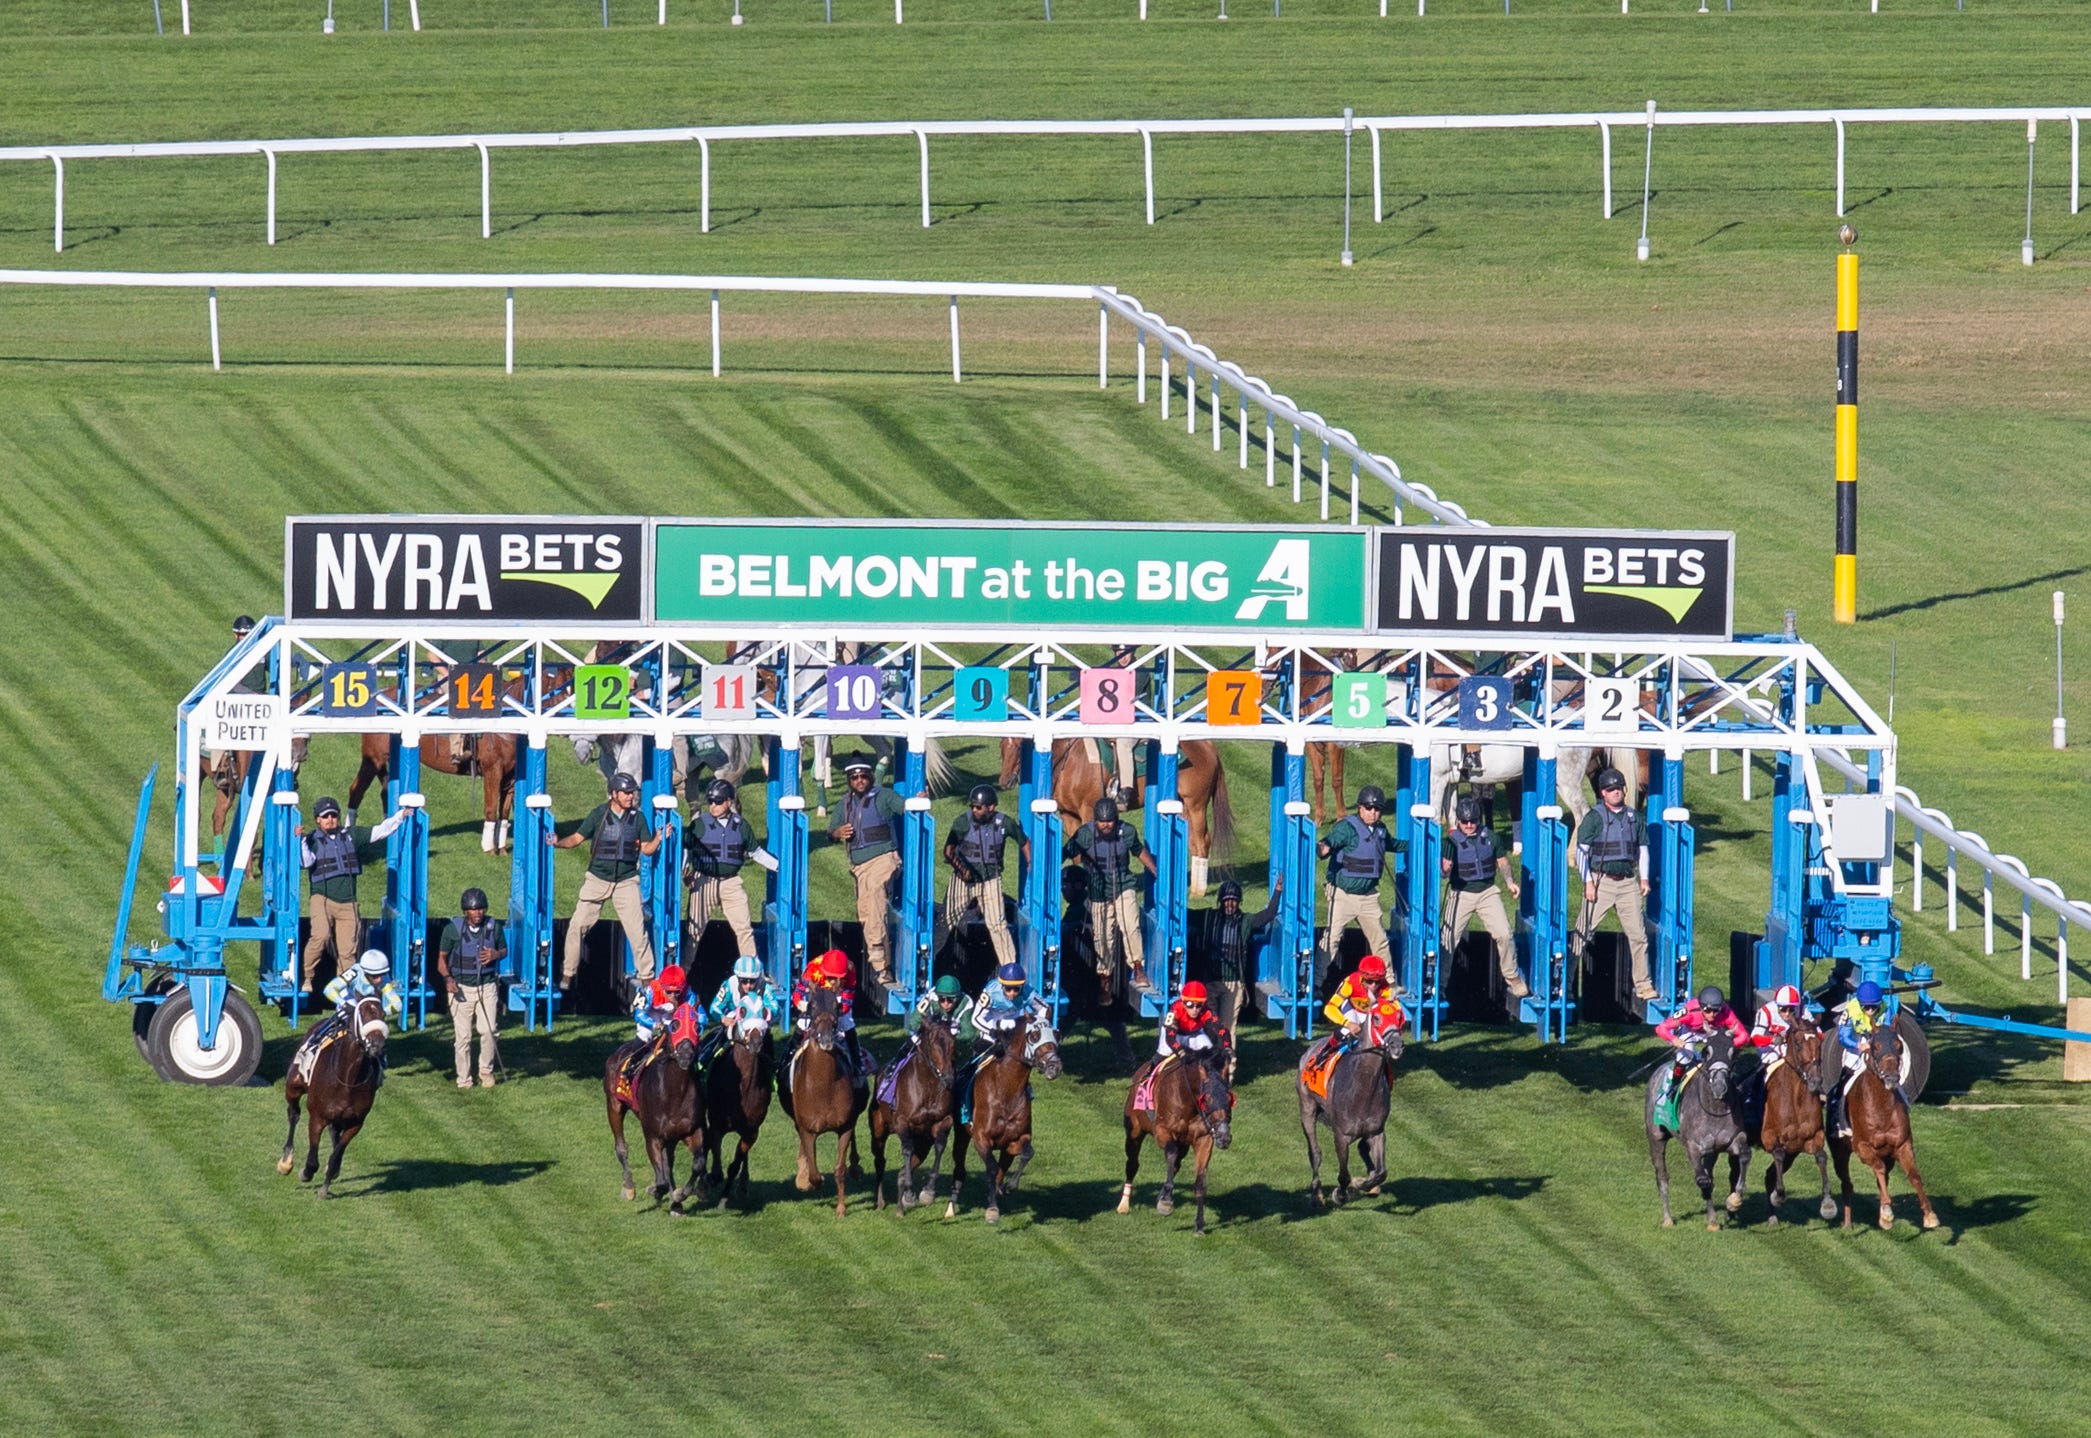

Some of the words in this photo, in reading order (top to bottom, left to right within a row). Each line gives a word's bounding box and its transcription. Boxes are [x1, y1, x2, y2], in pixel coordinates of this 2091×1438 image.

[315, 533, 493, 611] NYRA
[500, 533, 623, 571] BETS
[700, 554, 977, 599] BELMONT
[981, 559, 1031, 600] at
[1044, 557, 1126, 602] the
[1136, 560, 1230, 603] BIG
[1398, 543, 1576, 623] NYRA
[1583, 547, 1706, 586] BETS
[330, 671, 369, 707] 15
[454, 672, 496, 710] 14
[583, 675, 623, 710] 12
[713, 675, 744, 709] 11
[834, 675, 875, 712] 10
[971, 677, 993, 712] 9
[1097, 678, 1119, 713] 8
[1225, 682, 1247, 716] 7
[1347, 682, 1370, 719] 5
[1475, 685, 1498, 722] 3
[1601, 688, 1624, 721] 2
[215, 700, 272, 719] UNITED
[217, 721, 268, 741] PUETT
[980, 992, 990, 1008] 9
[1164, 1012, 1175, 1026] 8
